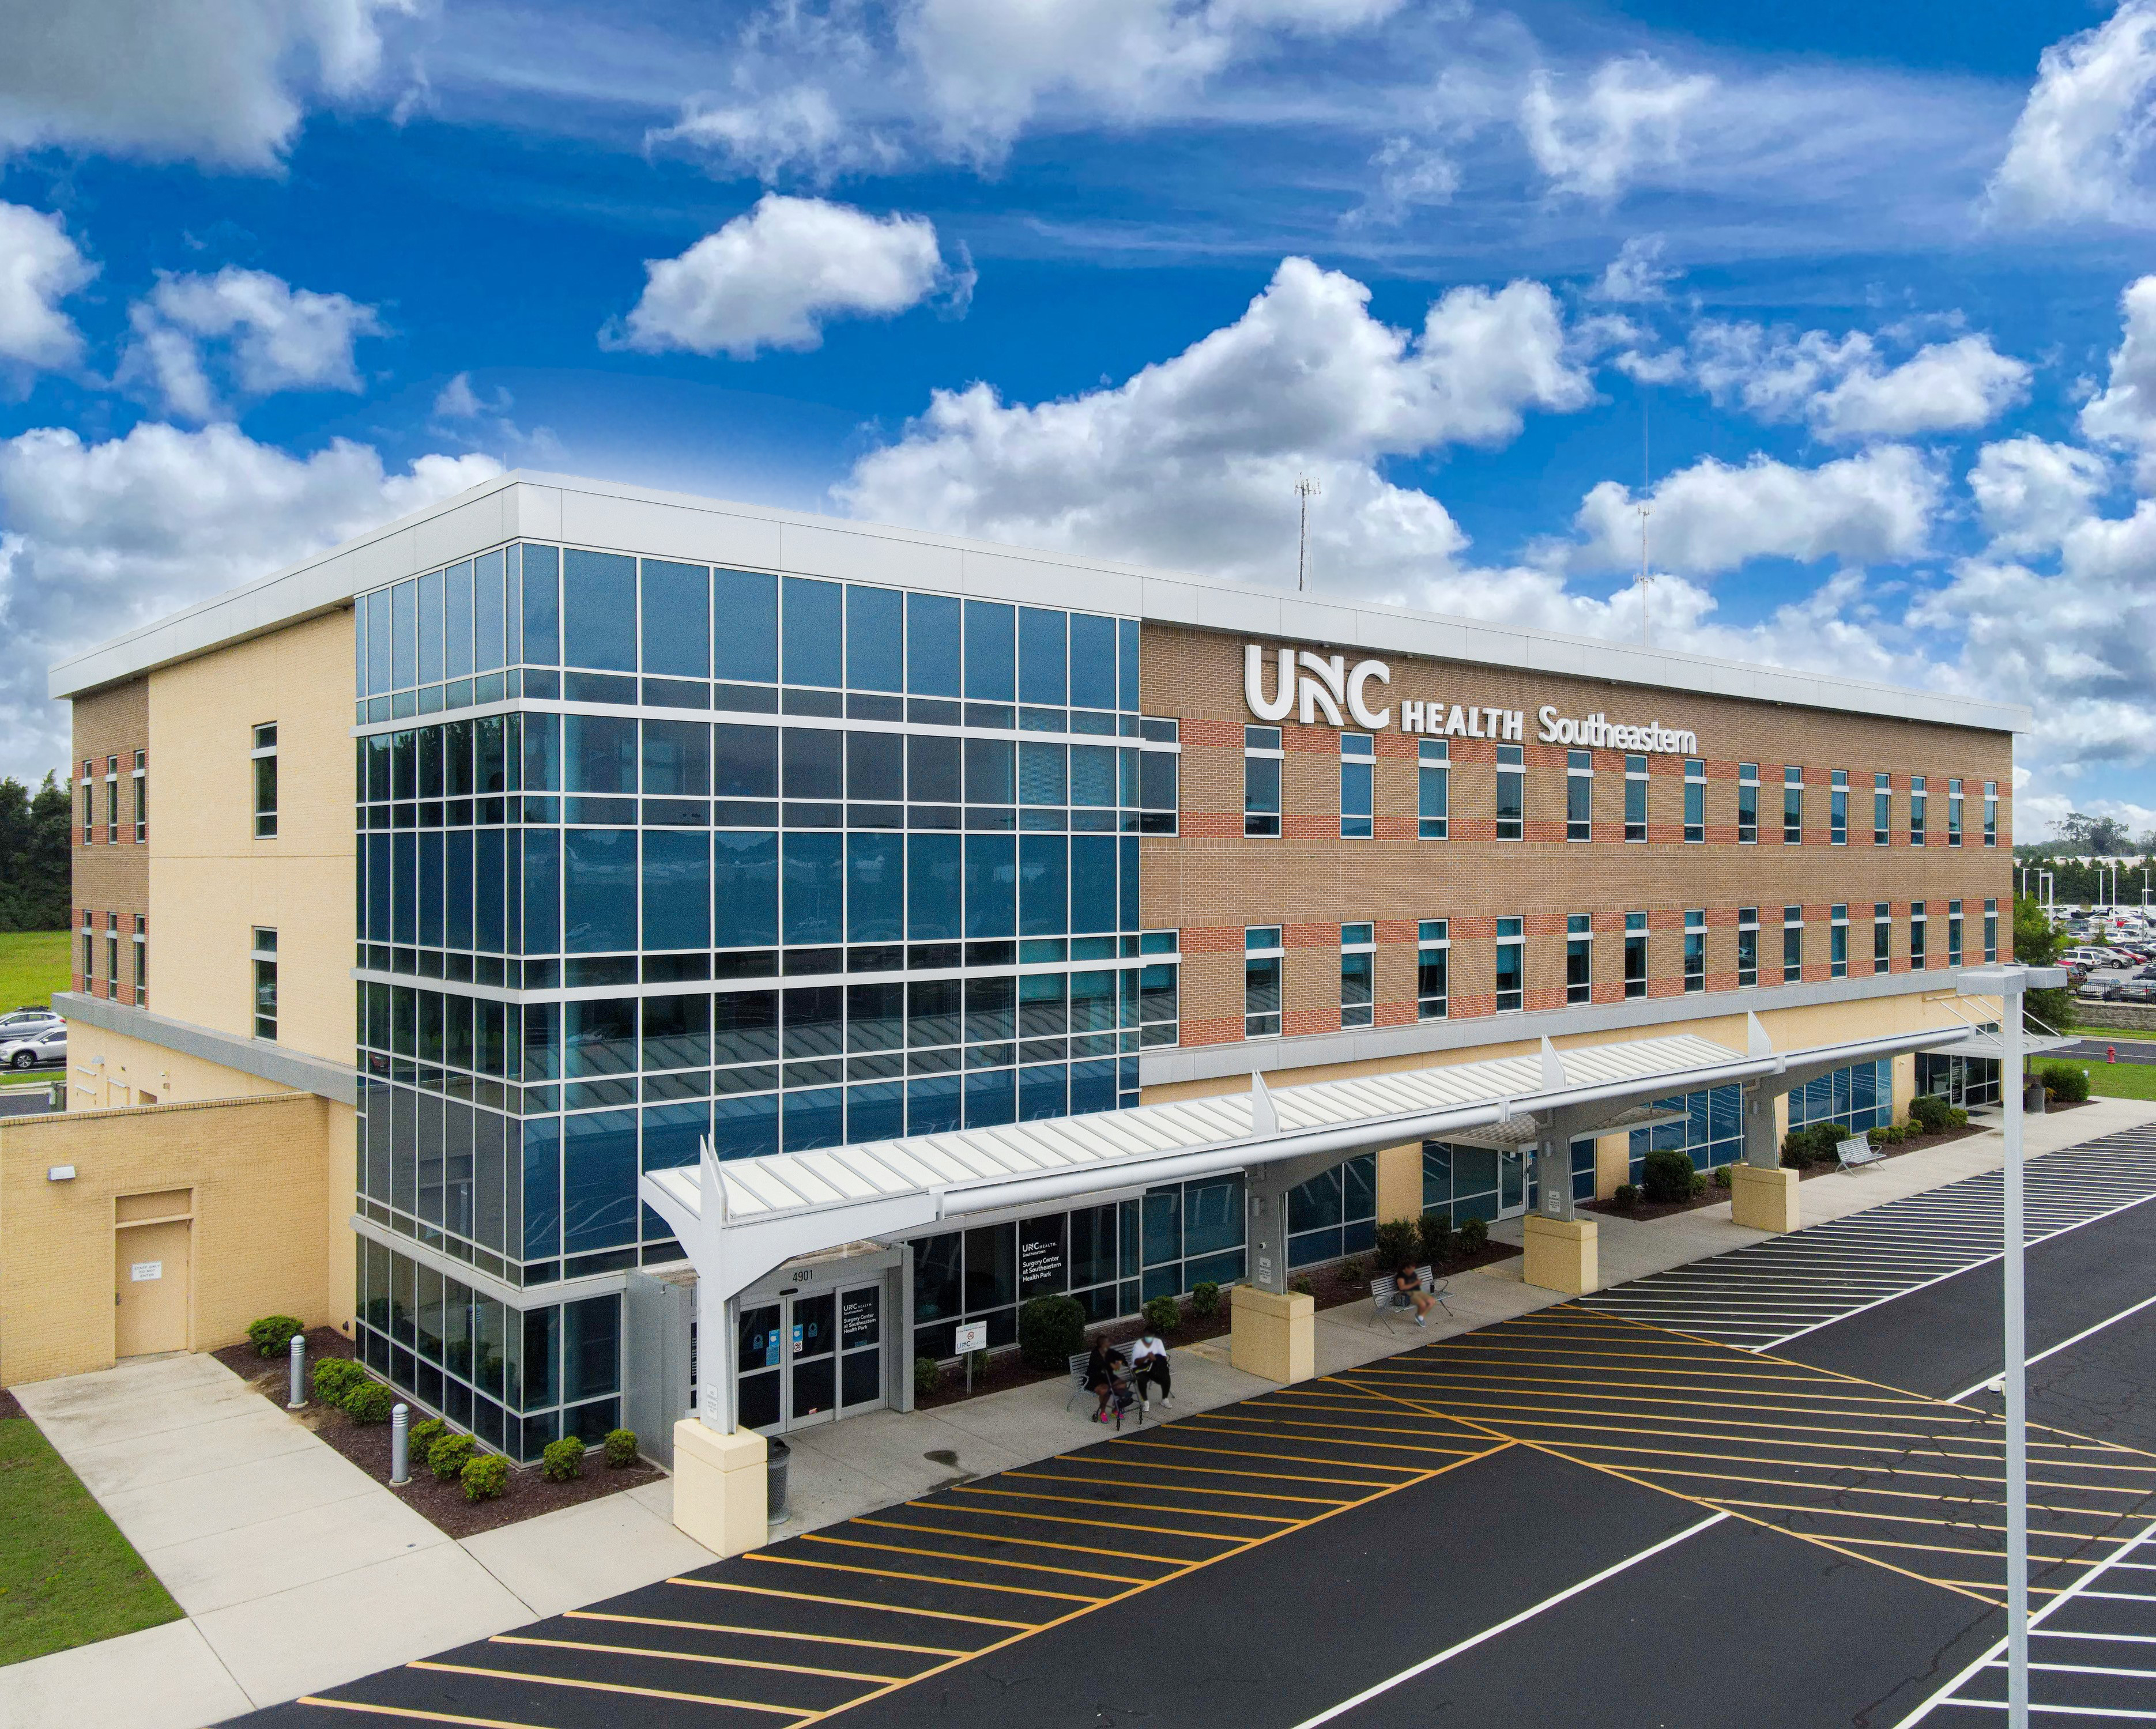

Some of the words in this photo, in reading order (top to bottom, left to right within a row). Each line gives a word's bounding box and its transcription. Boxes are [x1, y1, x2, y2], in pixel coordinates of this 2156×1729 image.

[1245, 644, 1390, 729] UNC
[1401, 700, 1523, 741] HEALTH
[1538, 705, 1697, 754] Southeastern
[1022, 1242, 1039, 1252] UNC
[1022, 1249, 1046, 1258] Southeastern
[1023, 1259, 1042, 1267] Surgery
[1028, 1262, 1061, 1273] Southeastern
[793, 1270, 812, 1282] 4901
[1023, 1274, 1039, 1282] Health
[843, 1303, 858, 1311] UNC
[849, 1318, 876, 1327] Southeastern
[957, 1341, 971, 1349] UNC
